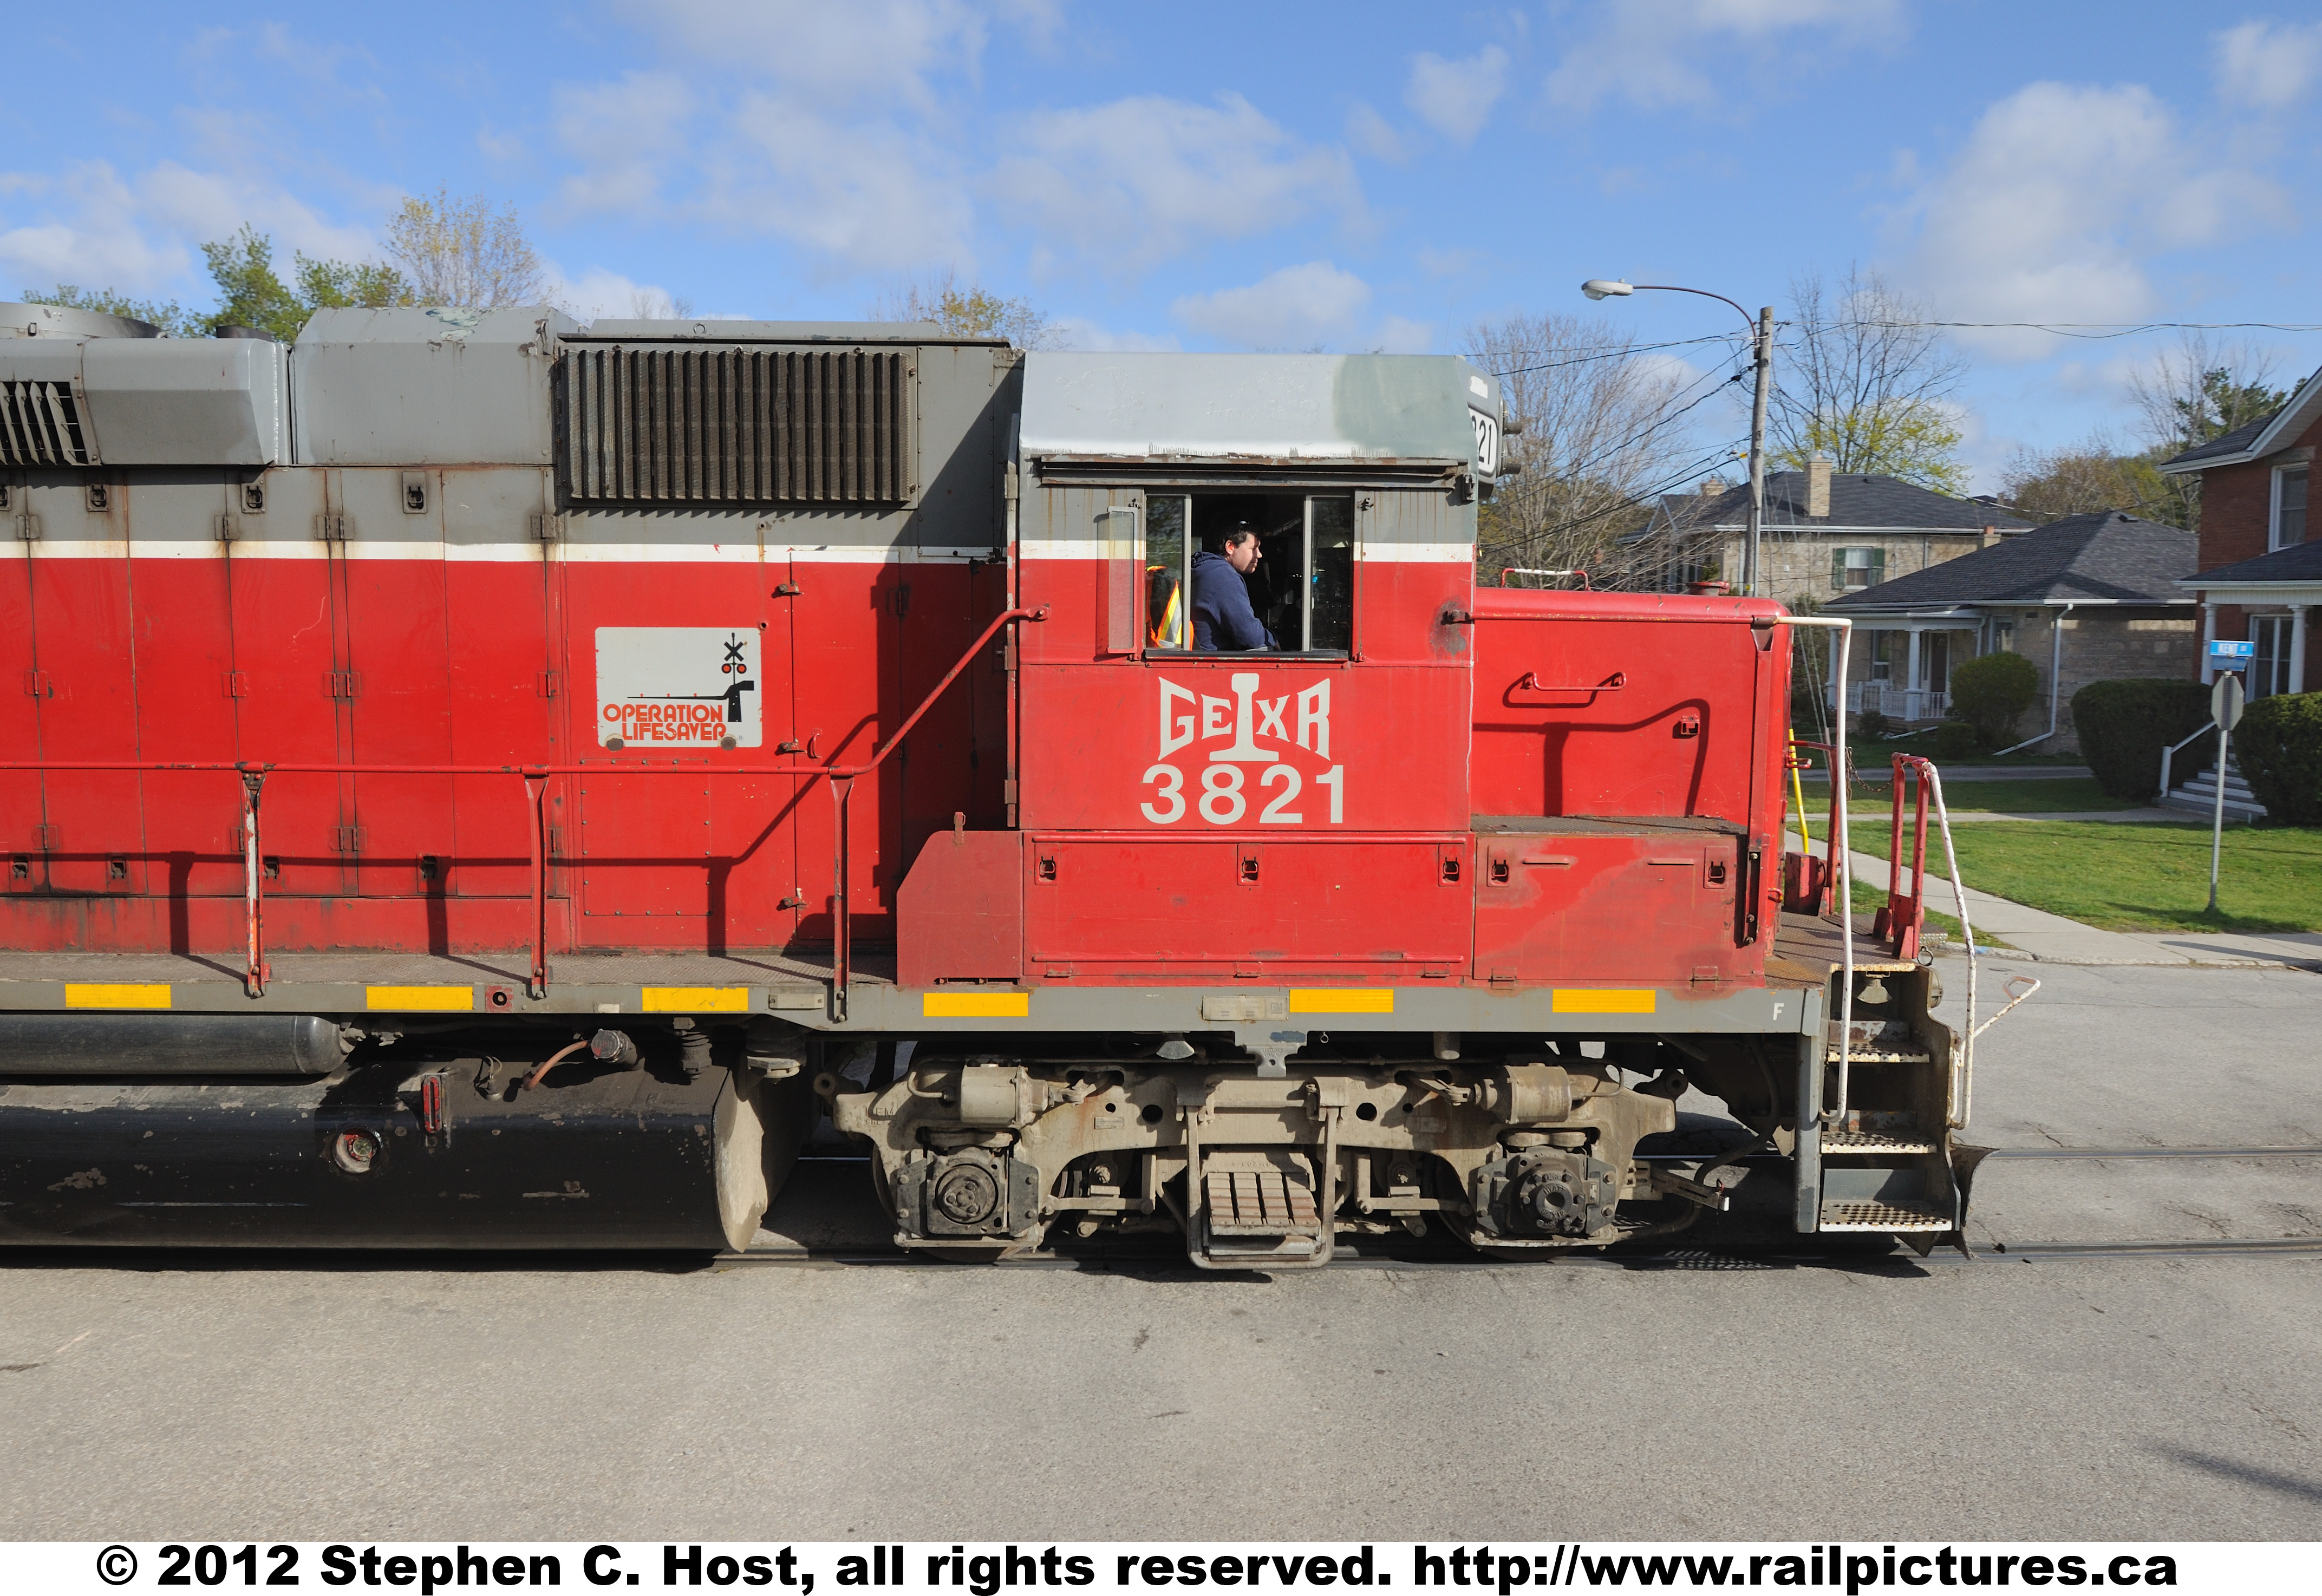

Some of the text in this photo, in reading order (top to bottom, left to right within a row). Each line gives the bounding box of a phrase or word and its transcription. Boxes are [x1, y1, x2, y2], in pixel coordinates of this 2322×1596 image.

[603, 704, 723, 723] OPERATION
[622, 722, 727, 741] LIFESAVER
[1140, 763, 1344, 825] 3821
[1270, 1002, 1283, 1011] GM
[1773, 1002, 1784, 1021] F
